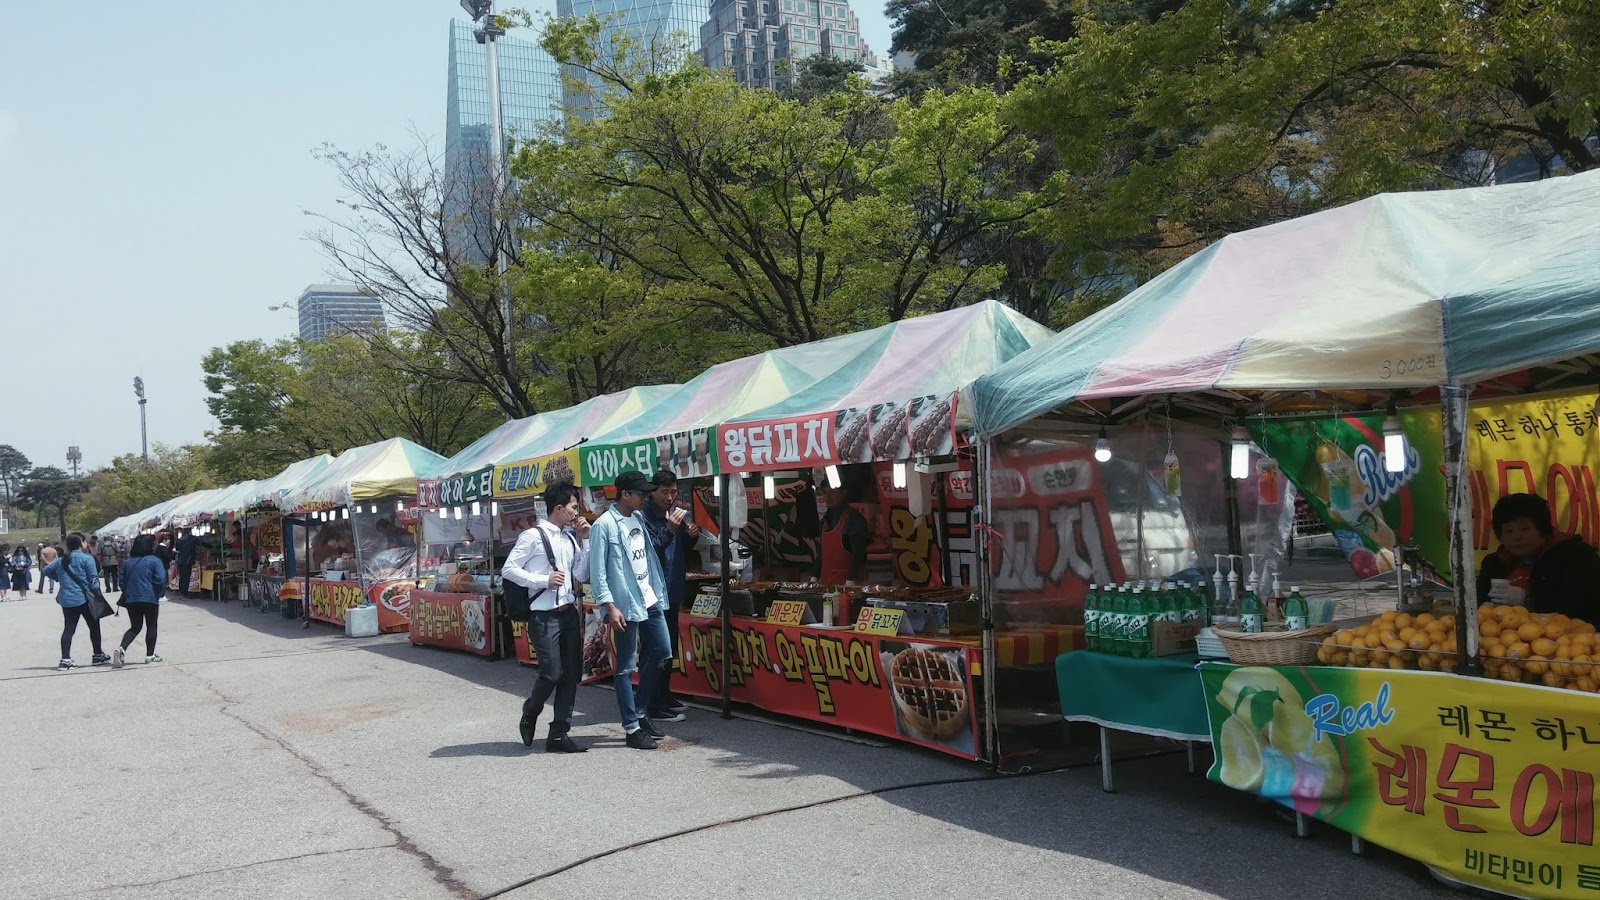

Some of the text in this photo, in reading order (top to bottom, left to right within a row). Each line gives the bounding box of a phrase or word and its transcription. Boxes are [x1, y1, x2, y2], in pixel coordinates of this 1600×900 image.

[724, 417, 832, 467] 왕닭꼬치
[1474, 418, 1514, 443] 레몬
[1518, 413, 1560, 440] 하나
[586, 442, 654, 480] 아이스티
[440, 469, 493, 505] 아이스티
[692, 594, 722, 616] 순한맛
[769, 600, 804, 623] 매운맛
[857, 607, 902, 633] 왕닭꼬치
[774, 629, 881, 716] 와플파이
[1305, 681, 1395, 742] Real
[1437, 704, 1516, 742] 레몬
[1366, 737, 1594, 846] 레몬에
[1463, 848, 1563, 889] 비타민이
